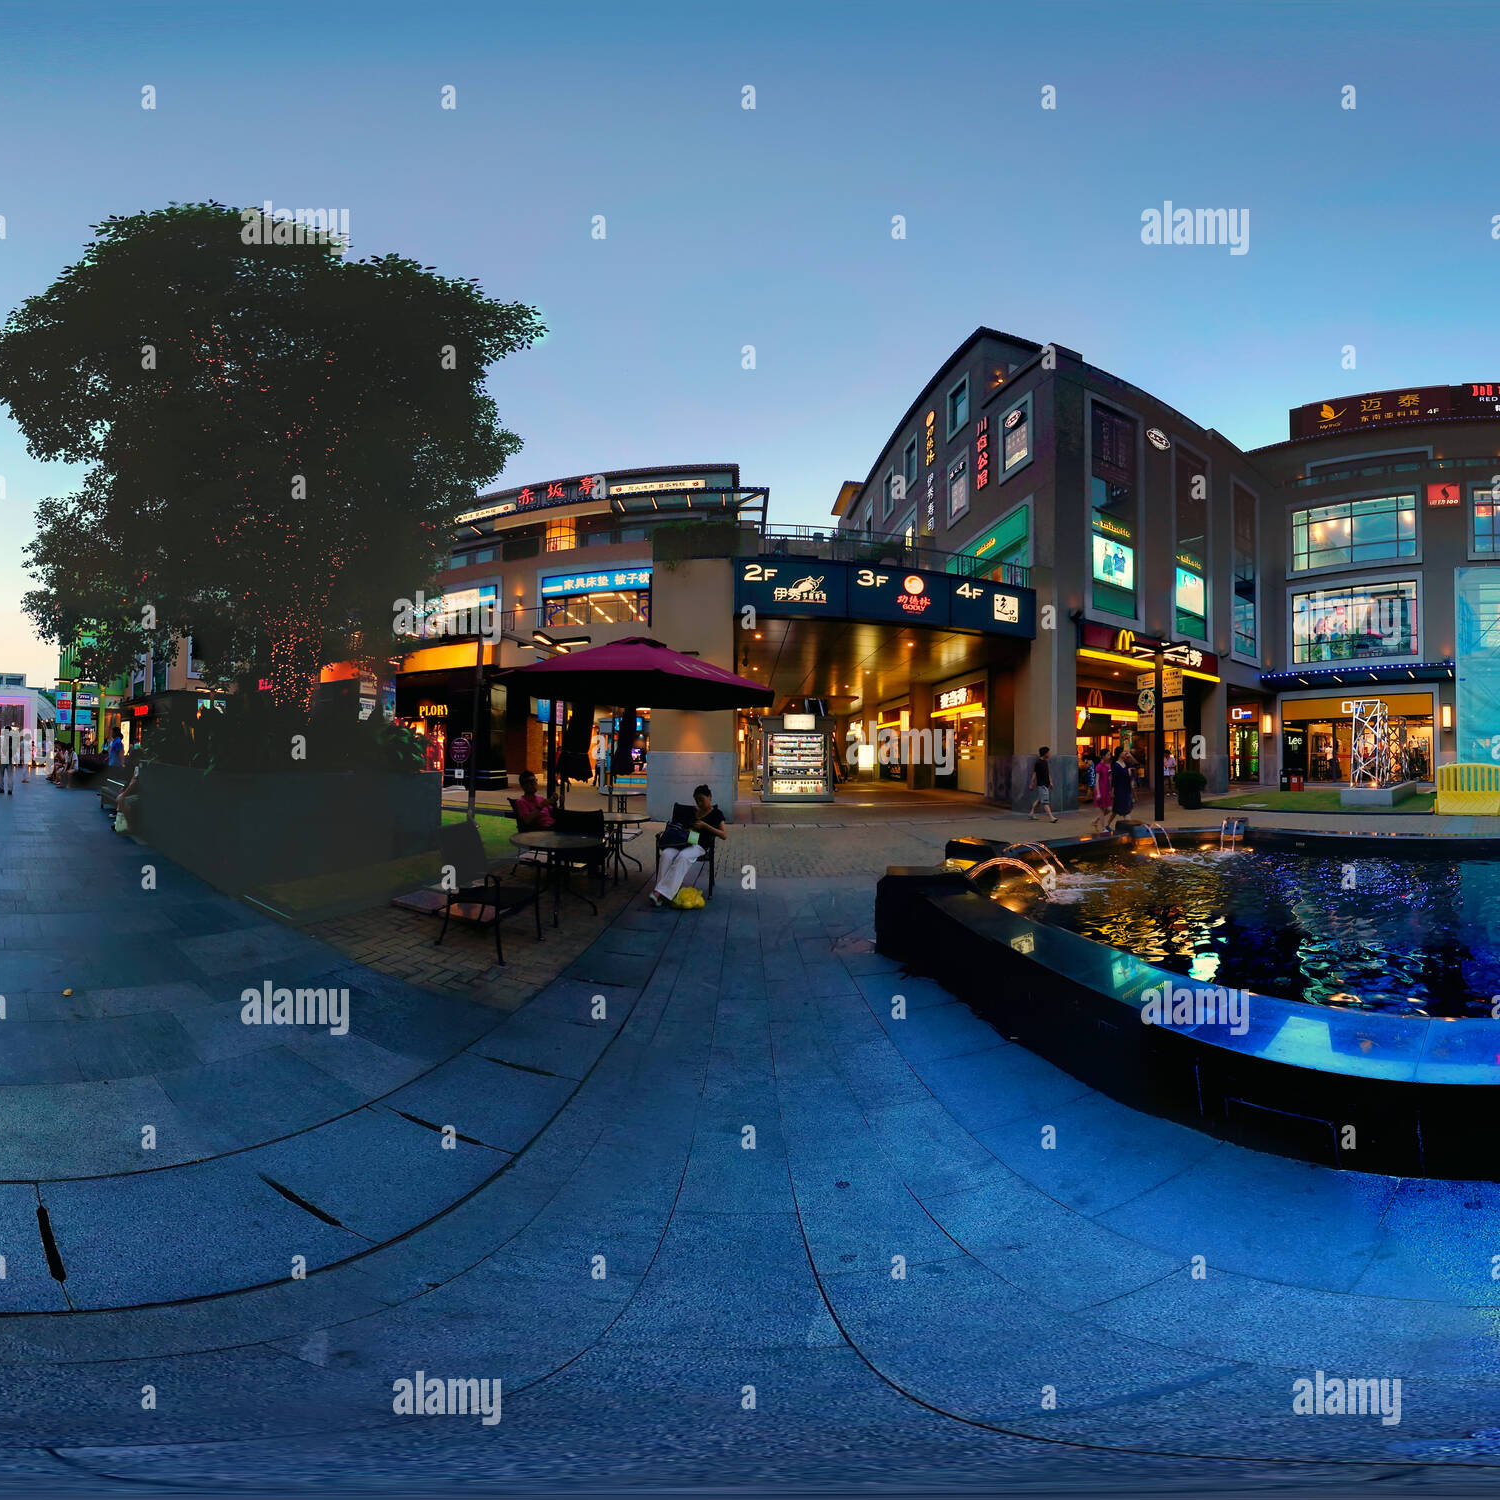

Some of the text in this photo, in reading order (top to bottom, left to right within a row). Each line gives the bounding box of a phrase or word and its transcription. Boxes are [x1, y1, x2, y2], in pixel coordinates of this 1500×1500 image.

[1360, 394, 1420, 412] 迈泰
[518, 476, 597, 505] 赤坂亭
[743, 564, 778, 582] 2F
[856, 569, 889, 588] 3F
[563, 575, 609, 590] 家具床垫
[956, 583, 984, 600] 4F
[897, 595, 931, 606] 功德林
[1288, 736, 1303, 745] Lee
